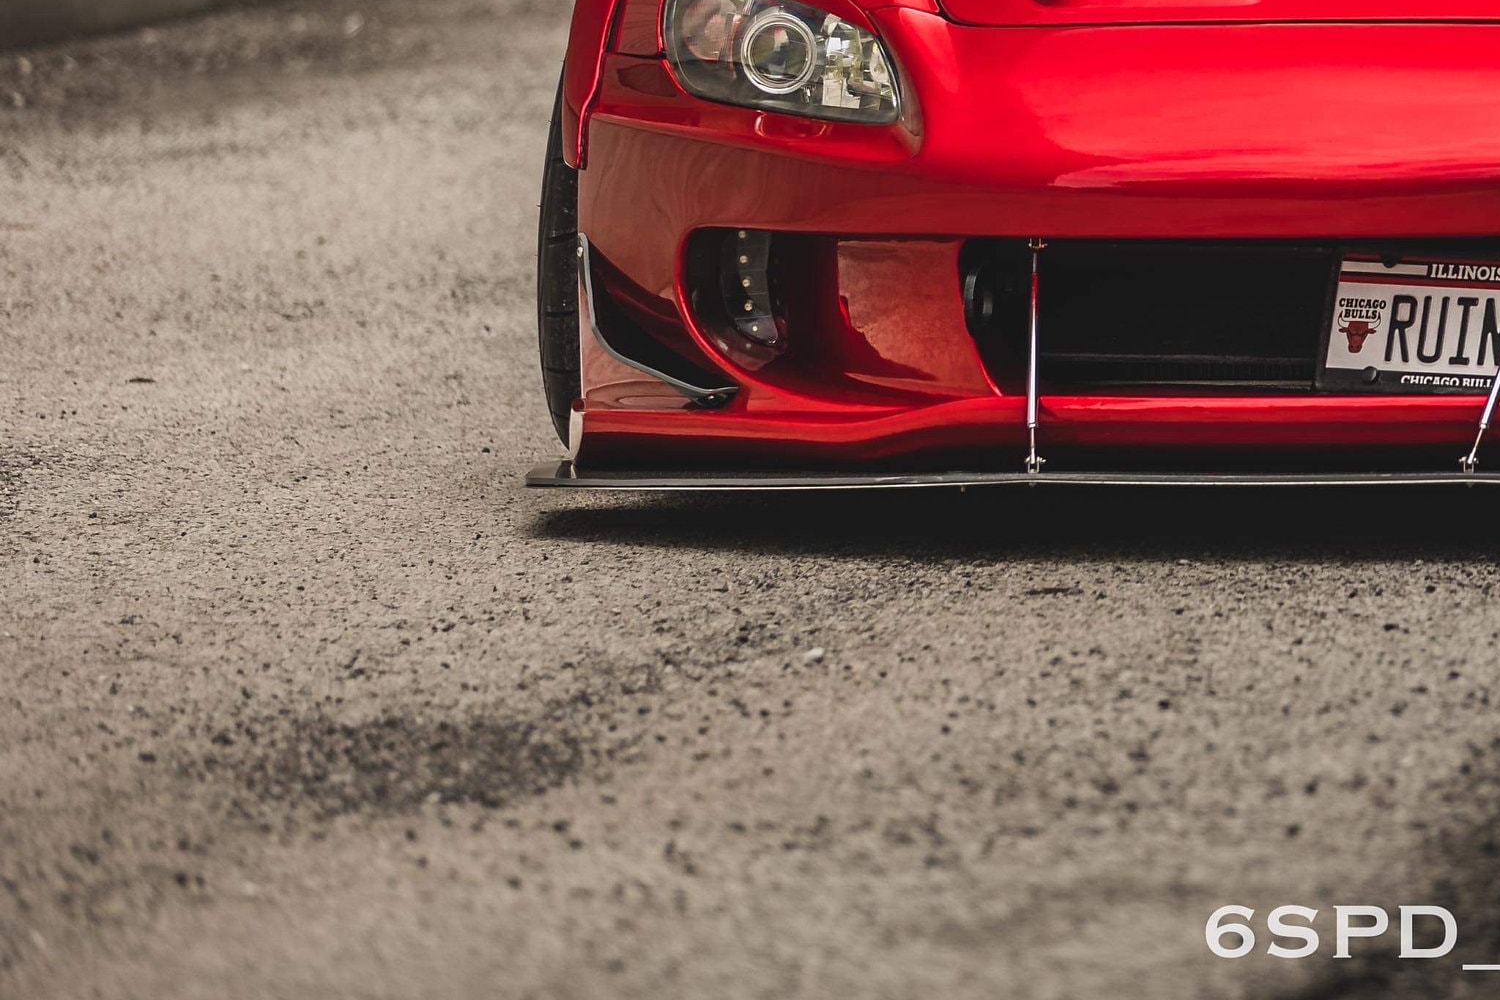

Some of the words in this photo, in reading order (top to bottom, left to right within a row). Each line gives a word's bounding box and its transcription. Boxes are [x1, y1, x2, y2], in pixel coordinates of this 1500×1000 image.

[1338, 297, 1387, 310] CHICAGO
[1342, 309, 1379, 320] BULLS
[1400, 374, 1460, 387] CHICAGO
[1461, 377, 1498, 388] BULL
